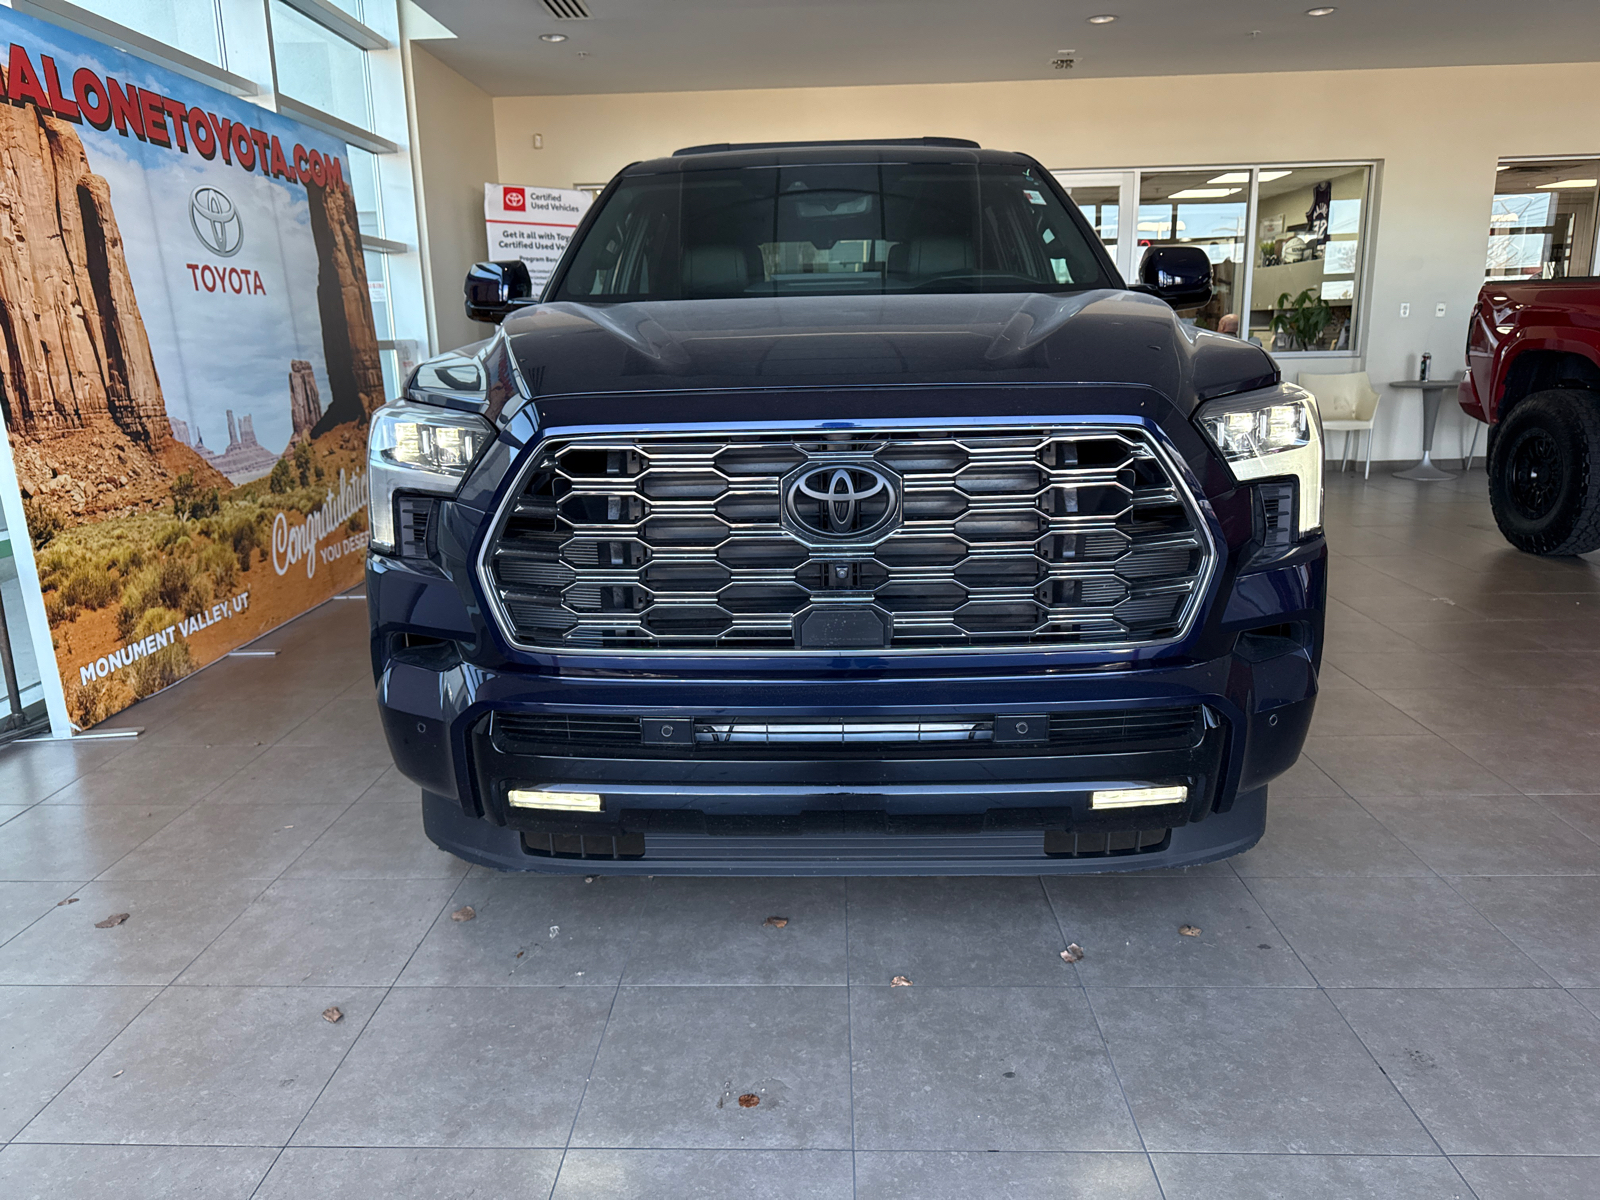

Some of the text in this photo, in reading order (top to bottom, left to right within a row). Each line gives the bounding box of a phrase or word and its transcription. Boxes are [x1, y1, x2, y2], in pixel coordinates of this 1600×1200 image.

[0, 43, 345, 192] ALONETOYOTA.COM
[530, 192, 562, 202] Certified
[531, 201, 579, 213] Used Vehicles
[502, 230, 518, 239] Get
[518, 230, 525, 239] it
[526, 231, 537, 240] all
[538, 232, 555, 241] with
[498, 240, 533, 250] Certified
[534, 242, 554, 250] Used
[519, 255, 544, 263] Program
[186, 262, 267, 296] TOYOTA
[320, 543, 341, 565] YOU
[79, 592, 249, 686] MONUMENT VALLEY, UT
